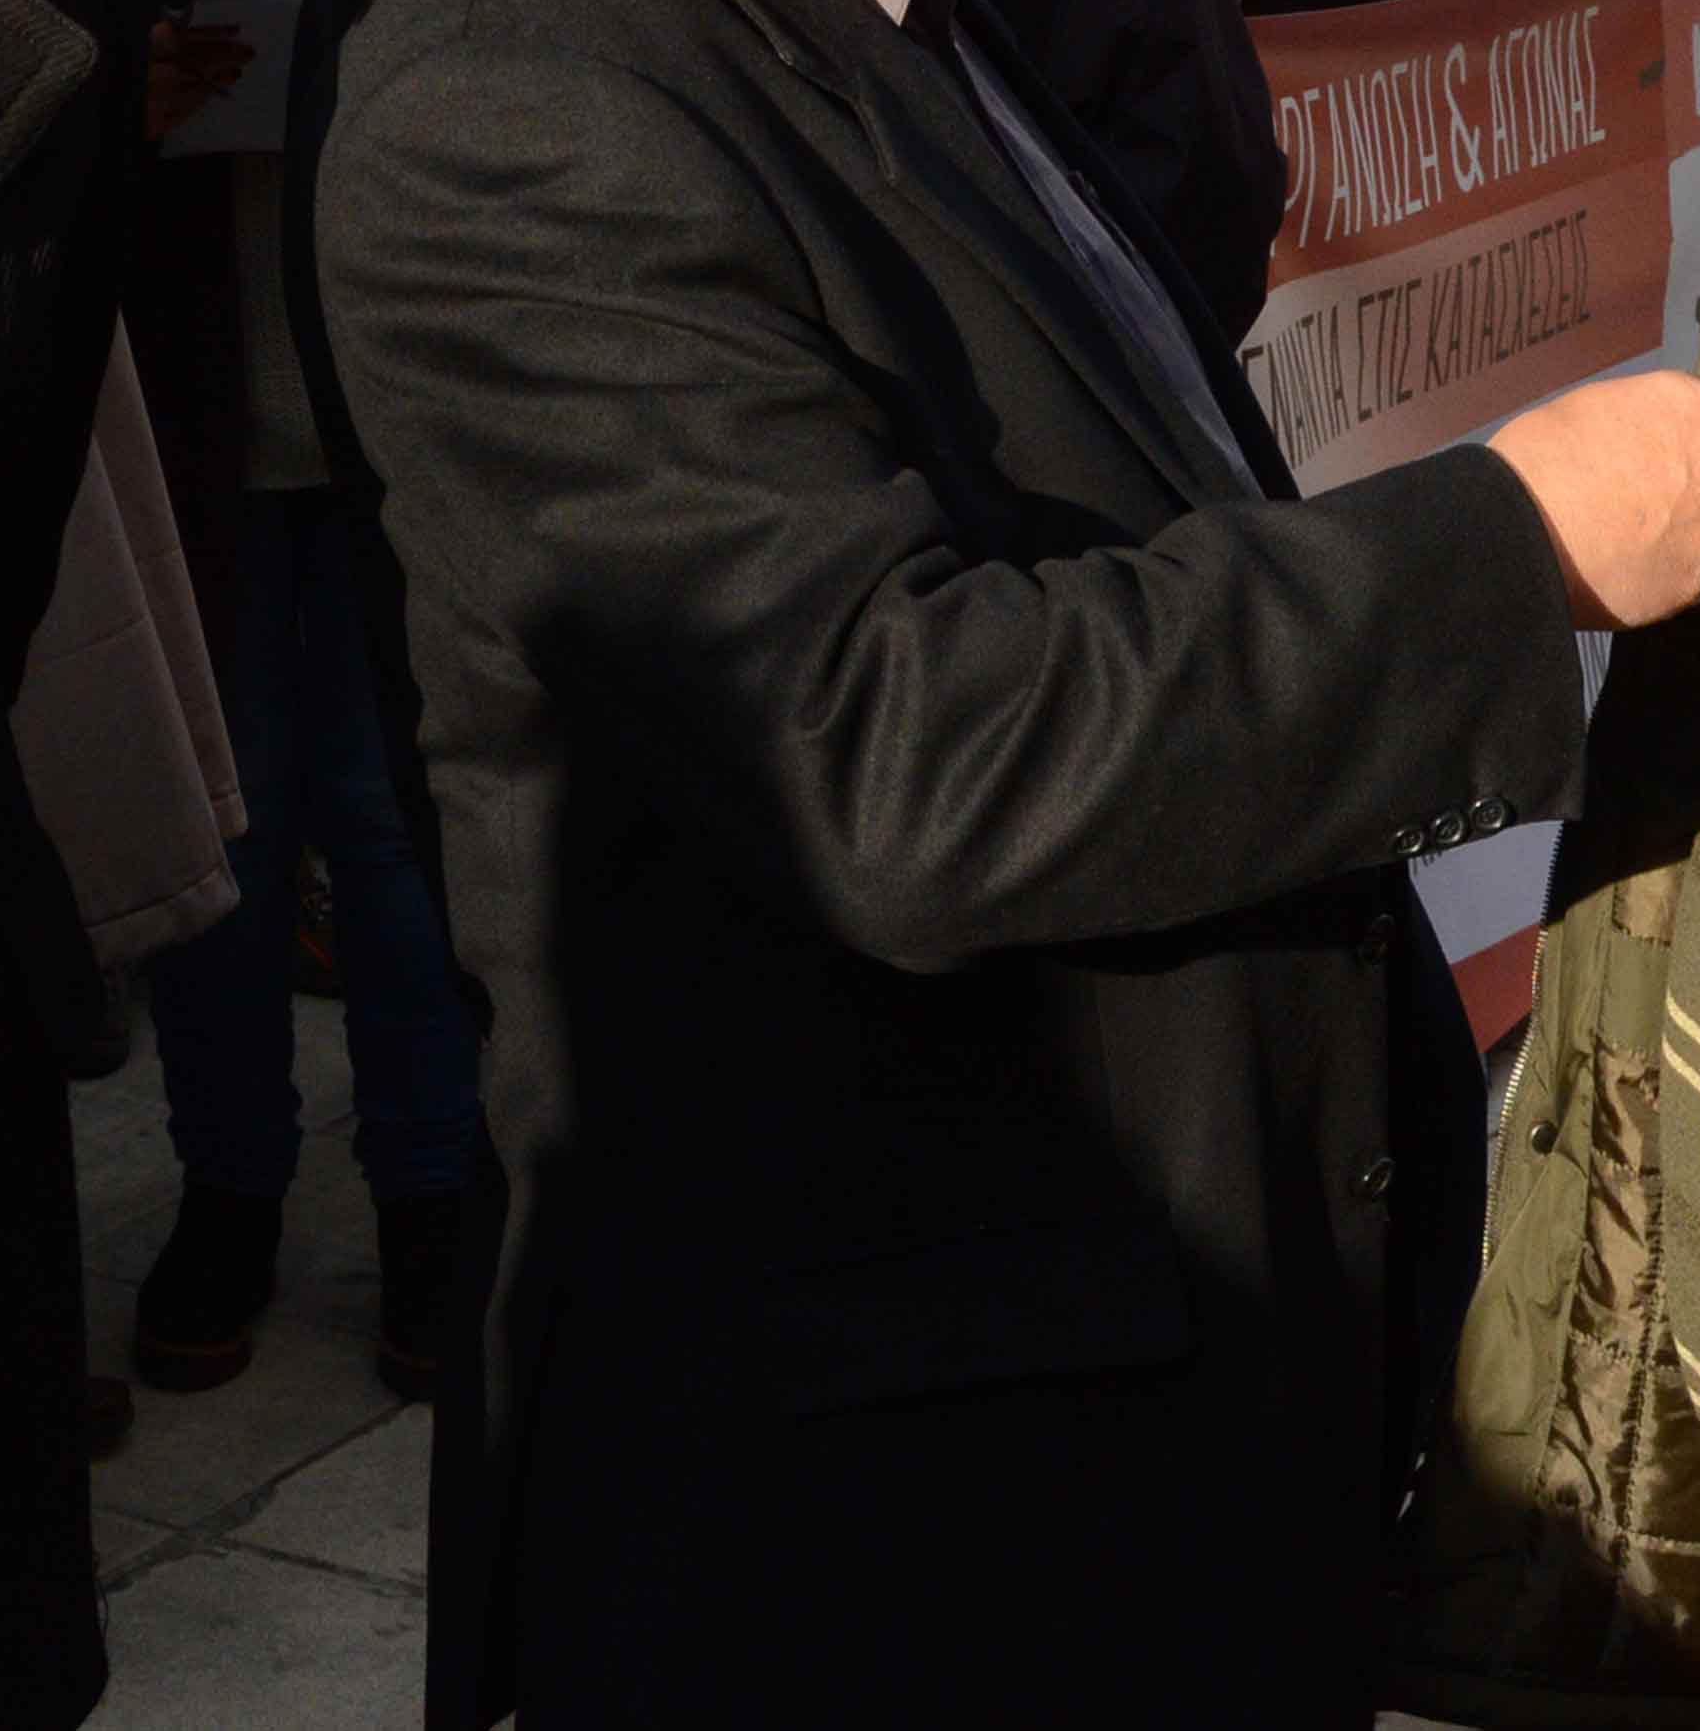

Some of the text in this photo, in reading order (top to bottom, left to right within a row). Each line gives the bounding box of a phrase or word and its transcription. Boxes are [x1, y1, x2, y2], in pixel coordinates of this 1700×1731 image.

[1270, 6, 1606, 257] ΡΓΑΝΩΣΗ & ΑΓΩΝΑΣ
[1357, 277, 1423, 422] ΣΤΙΣ
[1423, 210, 1591, 392] ΚΑΤΑΣΧΕΣΕΙΣ
